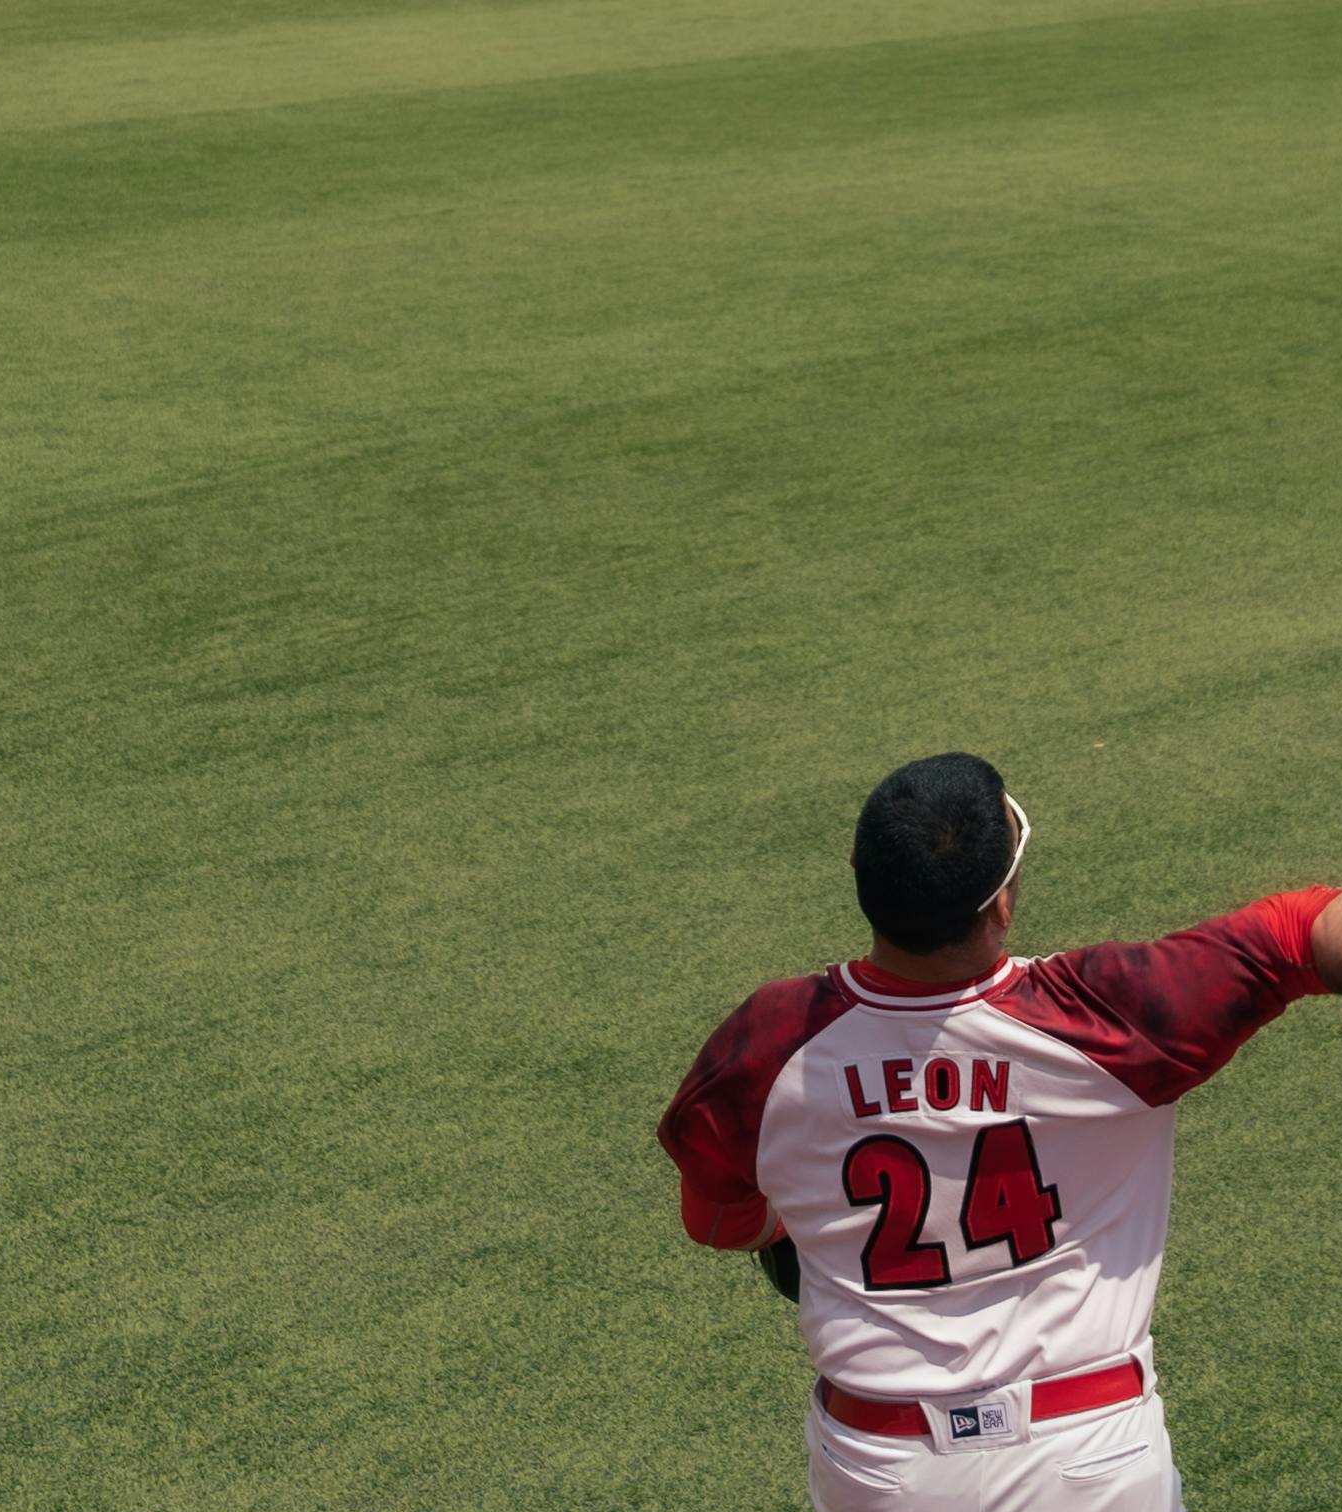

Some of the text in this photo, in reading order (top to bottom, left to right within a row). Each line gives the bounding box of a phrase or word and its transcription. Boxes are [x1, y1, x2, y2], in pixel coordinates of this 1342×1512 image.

[844, 1057, 1011, 1118] LEON
[842, 1116, 1063, 1292] 24
[981, 1409, 1003, 1421] NEW
[983, 1418, 1004, 1430] ERA
